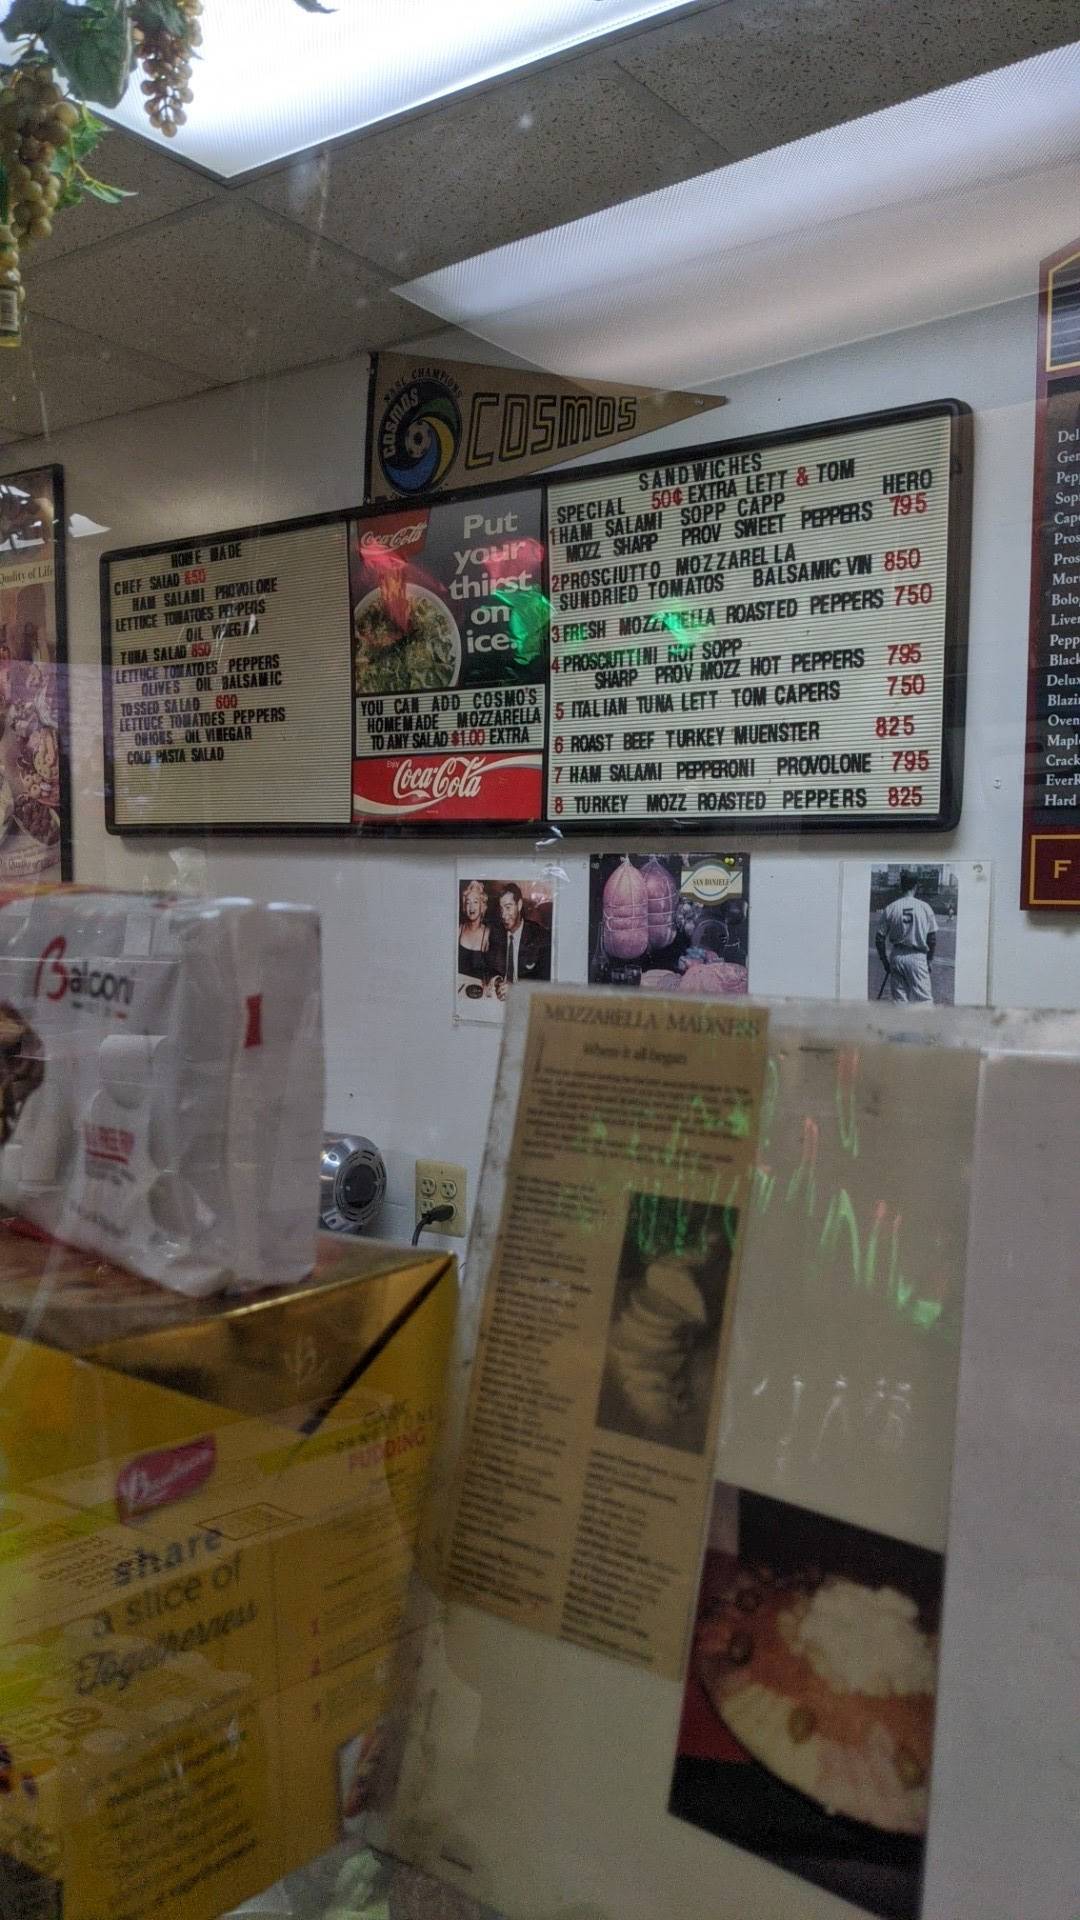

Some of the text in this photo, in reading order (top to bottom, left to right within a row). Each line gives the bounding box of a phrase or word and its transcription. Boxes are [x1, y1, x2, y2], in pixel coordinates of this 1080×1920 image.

[383, 387, 419, 459] COSMOS
[464, 392, 637, 471] COSMOS
[639, 452, 762, 491] SANDWICHES
[652, 458, 855, 510] 50¢ EXTRA LETT & TOM
[883, 469, 932, 495] HERO
[557, 497, 625, 524] SPECIAL
[560, 523, 592, 544] HAM
[605, 511, 663, 537] SALAMI
[681, 502, 726, 526] SOPP
[737, 492, 785, 517] CAPP
[613, 533, 658, 556] SHARP
[682, 523, 722, 547] PROV
[734, 513, 786, 539] SWEET
[801, 501, 873, 530] PEPPERS
[889, 492, 928, 516] 795
[464, 512, 518, 539] Put
[210, 543, 242, 561] MADE
[453, 541, 526, 575] your
[552, 542, 796, 592] 2 PROSCIUTTO MOZZARELLA
[560, 548, 921, 611] SUNDRIED TOMATOS BALSAMIC VIN 850
[114, 572, 180, 596] CHEF SALAD
[132, 577, 278, 611] HAM SALAMI PROVOLONE
[449, 570, 532, 600] thirst
[116, 614, 158, 632] LETTUCE
[164, 606, 214, 626] TOMATOES
[470, 605, 510, 626] on
[552, 626, 560, 643] 3
[563, 620, 606, 642] FRESH
[727, 599, 797, 624] ROASTED
[810, 588, 884, 615] PEPPERS
[894, 583, 932, 606] 750
[186, 628, 204, 642] OIL
[466, 630, 517, 654] ice.
[116, 654, 279, 684] LETTUCE TOMATOES PEPPERS
[121, 650, 148, 665] TUNA
[153, 645, 187, 661] SALAD
[552, 656, 560, 673] 4
[563, 647, 658, 673] PROSCIUTTINI
[702, 638, 742, 660] SOPP
[594, 643, 922, 689] SHARP PROV MOZZ HOT PEPPERS 795
[142, 671, 282, 697] OLIVES OIL BALSAMIC
[555, 674, 925, 720] 5 ITALIAN TUNA LETT TOM CAPERS 750
[121, 694, 238, 716] TOSSED SALAD 600
[361, 687, 537, 716] YOU CAN ADD COSMO'S
[120, 707, 286, 732] LETTUCE TOMATOES PEPPERS
[367, 707, 541, 733] HOMEMADE MOZZARELLA
[135, 726, 252, 746] ONIONS OIL VINEGAR
[371, 726, 529, 751] TO ANY SALAD $1.00 EXTRA
[554, 715, 915, 753] 6 ROAST BEEF TURKEY MUENSTER 825
[156, 749, 186, 763] PASTA
[191, 747, 224, 762] SALAD
[554, 751, 929, 783] 7 HAM SALAMI PEPPERONI PROVOLONE 795
[393, 757, 487, 799] Coca-Cola
[554, 786, 922, 814] 8 TURKEY MOZZ ROASTED PEPPERS 825
[1044, 794, 1077, 806] Hard
[1054, 860, 1072, 879] F
[903, 908, 914, 924] 5
[546, 1003, 657, 1030] MOZZARELLA
[114, 1529, 222, 1586] share
